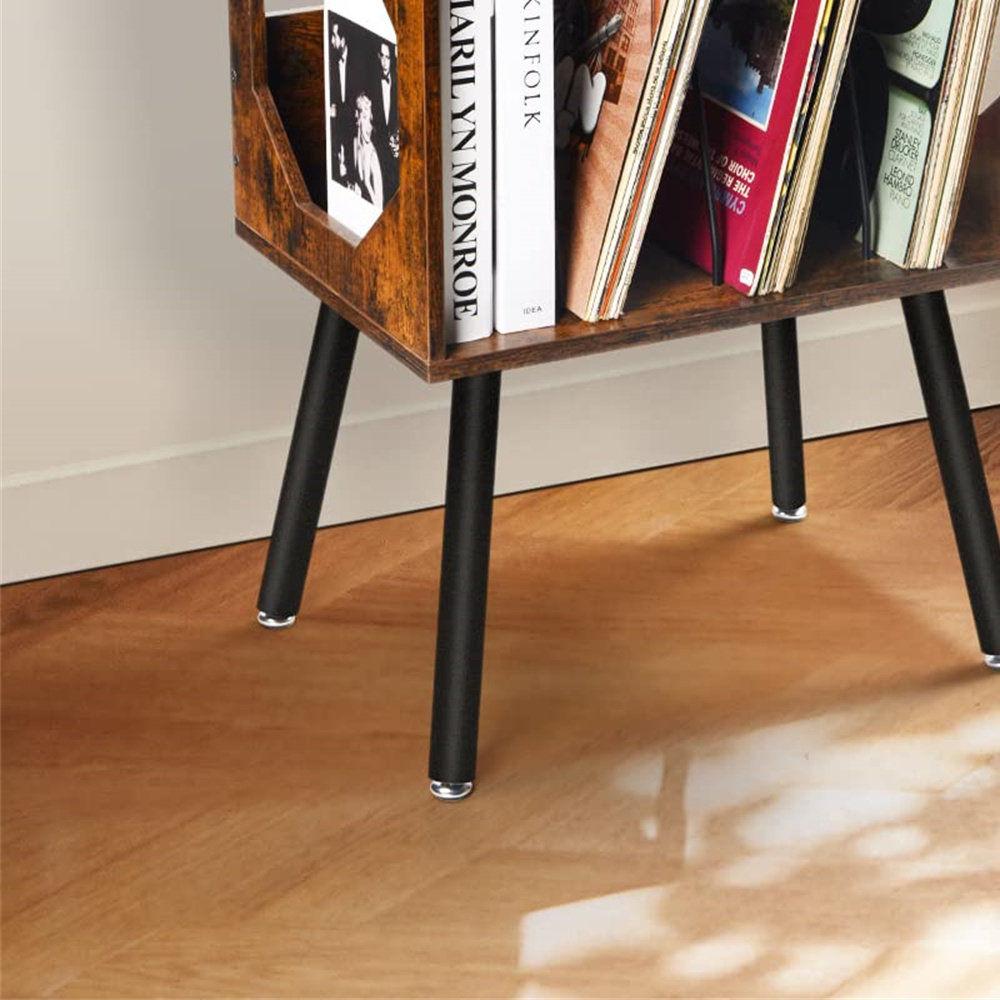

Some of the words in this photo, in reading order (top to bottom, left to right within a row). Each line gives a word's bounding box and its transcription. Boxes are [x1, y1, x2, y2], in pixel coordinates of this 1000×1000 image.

[727, 159, 755, 183] CHOIR
[732, 179, 751, 198] THE
[452, 161, 478, 321] MONROE
[523, 306, 542, 316] IDEA
